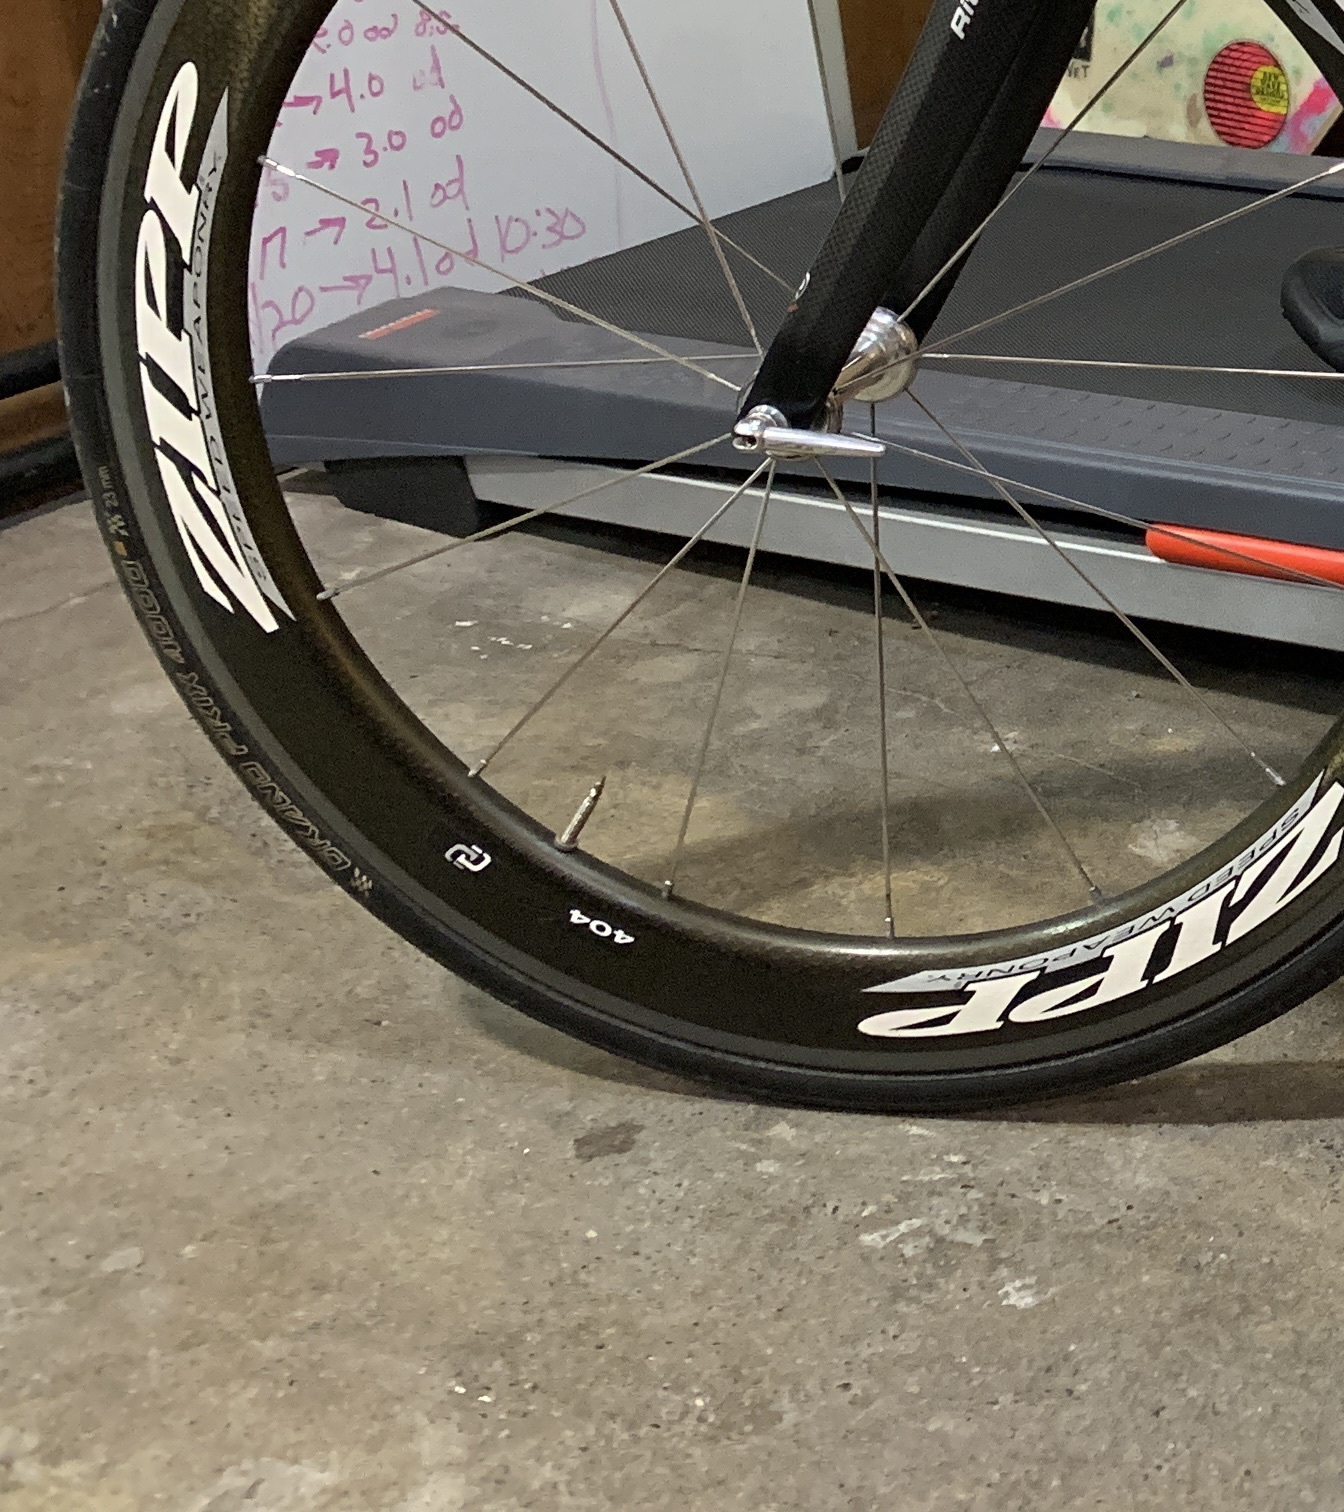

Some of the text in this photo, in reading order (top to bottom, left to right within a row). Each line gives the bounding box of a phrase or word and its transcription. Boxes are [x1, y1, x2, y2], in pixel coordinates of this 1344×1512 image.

[329, 67, 385, 113] 4.0
[355, 130, 407, 168] 3.0
[134, 59, 280, 634] ZIPP
[121, 559, 352, 872] GRAND PRIX 4000
[1187, 806, 1301, 901] SPEED
[568, 908, 637, 946] 404
